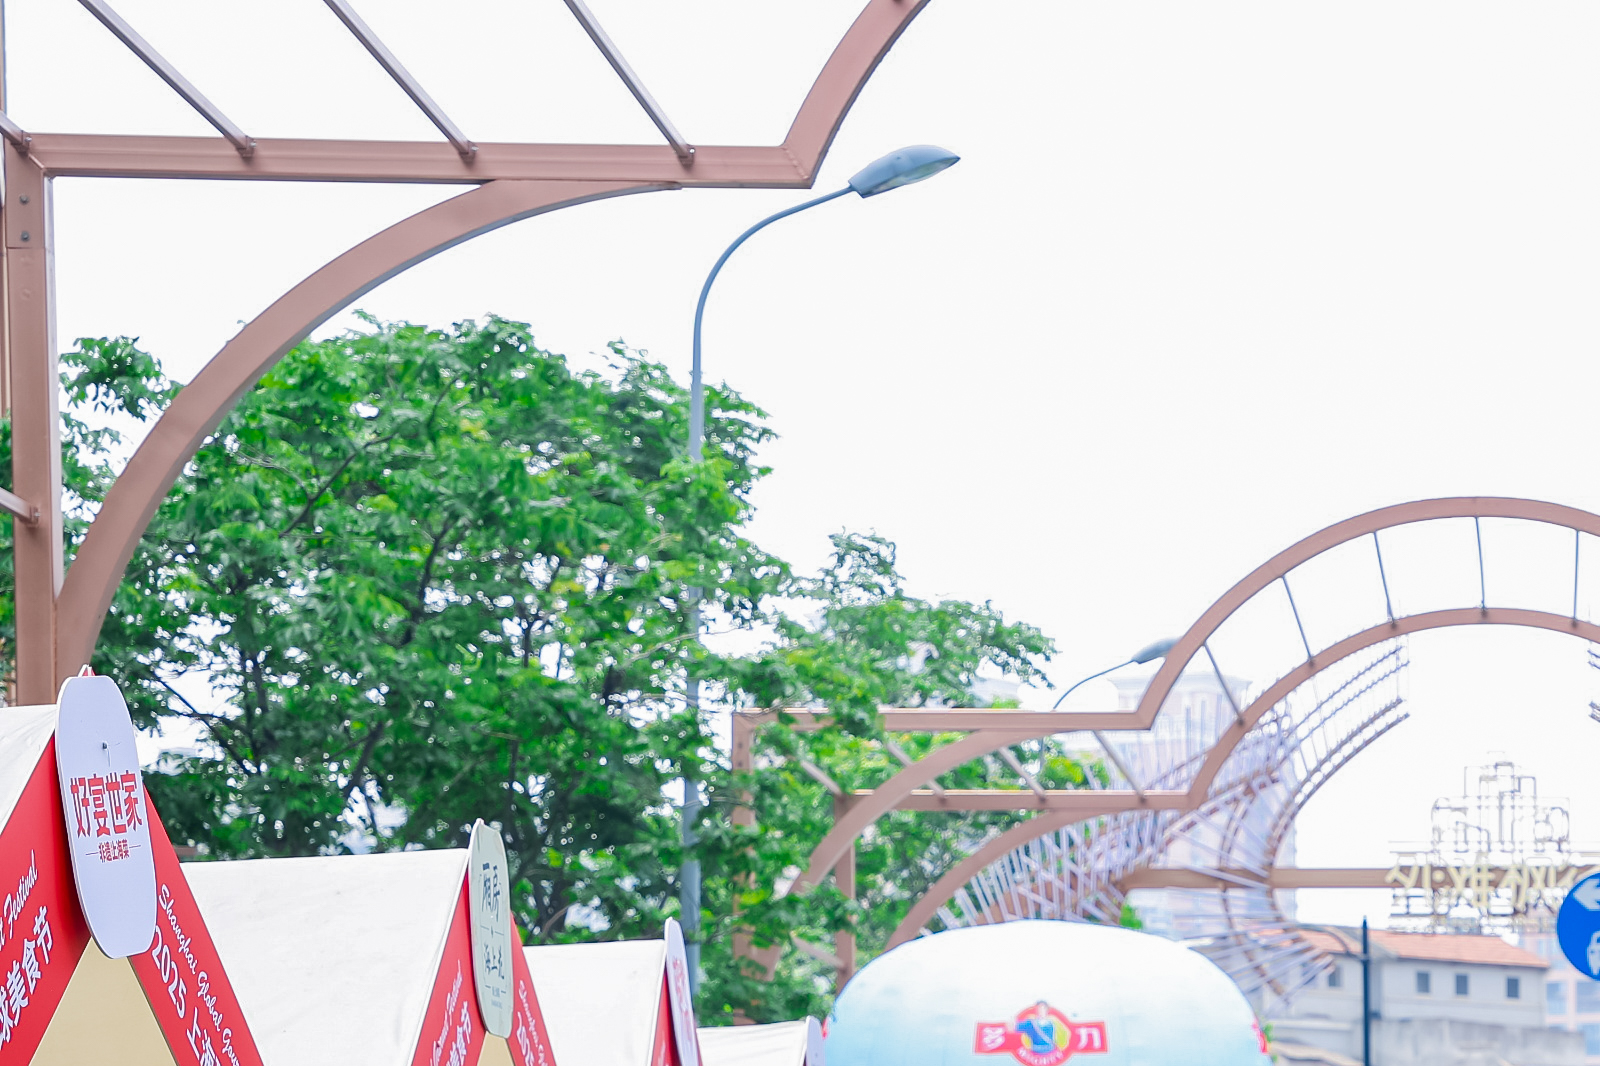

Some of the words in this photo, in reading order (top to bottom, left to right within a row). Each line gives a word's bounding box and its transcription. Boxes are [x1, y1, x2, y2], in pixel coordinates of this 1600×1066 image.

[70, 770, 142, 838] 好宴世家
[4, 849, 38, 939] Festival
[152, 925, 188, 1019] 2025
[159, 884, 197, 975] Shanghai
[197, 972, 221, 1032] Global
